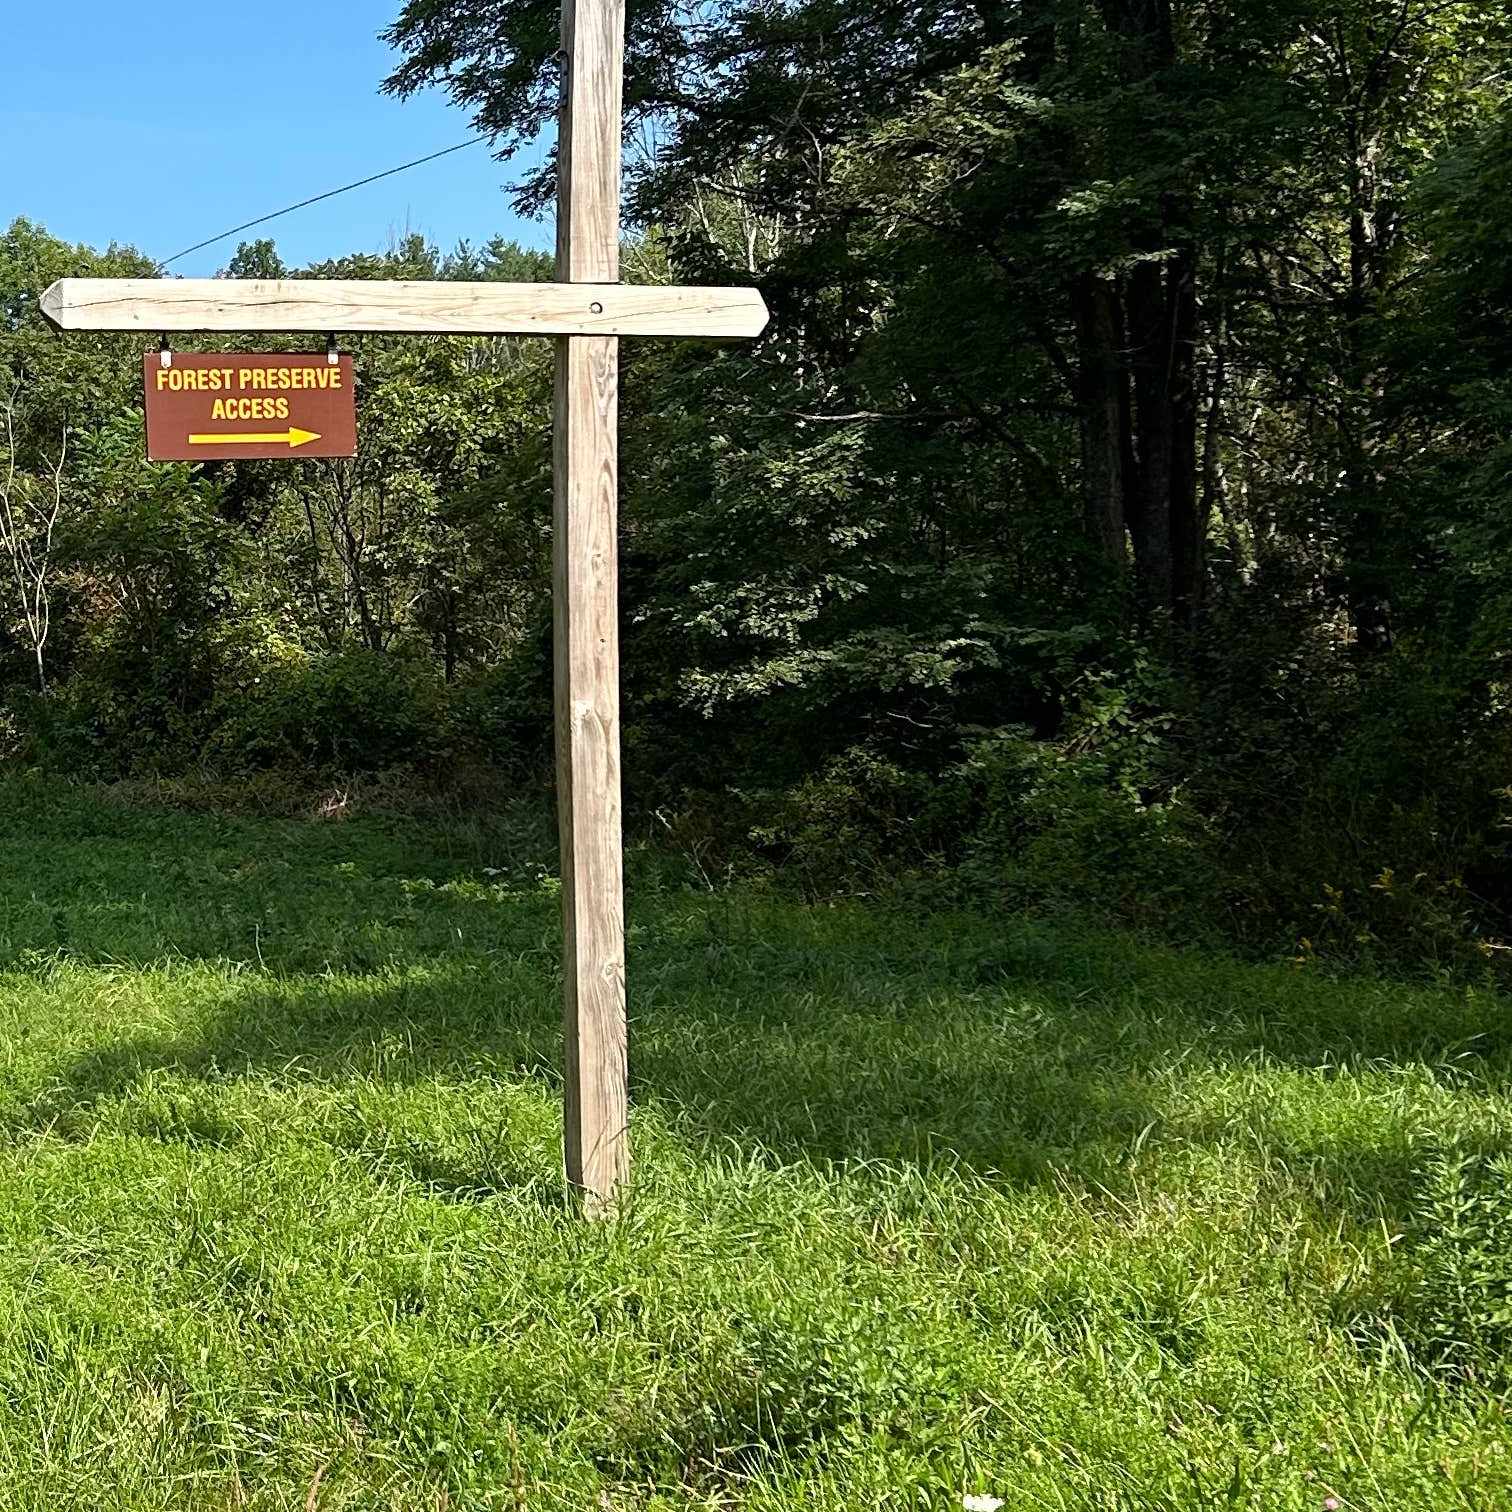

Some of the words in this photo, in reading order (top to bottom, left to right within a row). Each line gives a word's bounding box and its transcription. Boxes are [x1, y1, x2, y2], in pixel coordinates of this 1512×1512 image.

[156, 368, 234, 391] FOREST
[239, 367, 342, 389] PRESERVE
[211, 398, 289, 420] ACCESS
